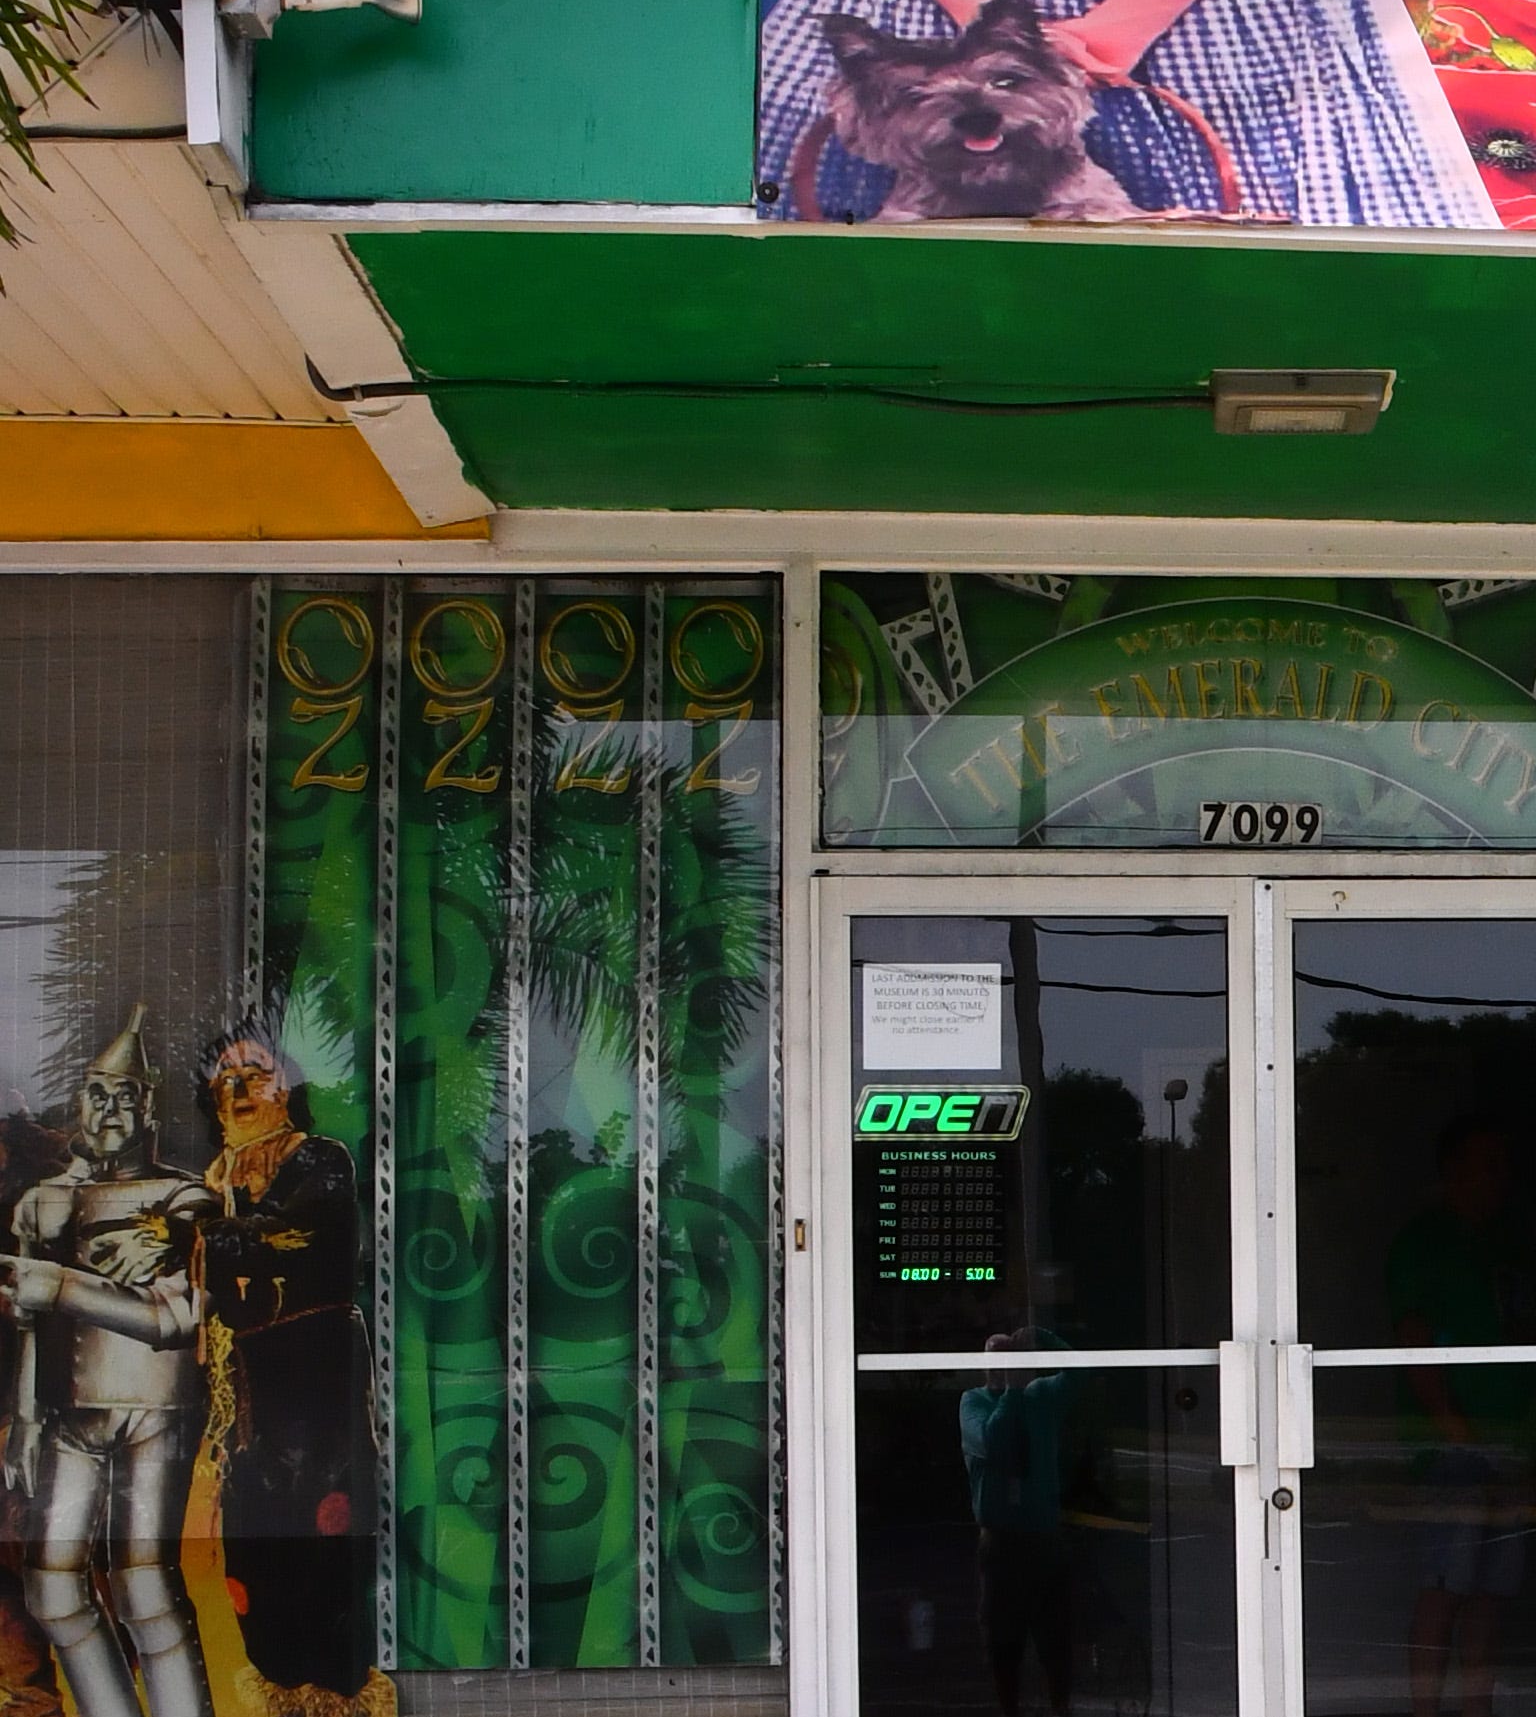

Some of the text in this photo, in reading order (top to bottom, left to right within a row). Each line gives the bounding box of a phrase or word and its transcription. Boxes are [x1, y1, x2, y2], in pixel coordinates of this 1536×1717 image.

[1115, 617, 1399, 661] WELCOME TO
[950, 701, 1082, 813] THE
[1090, 657, 1393, 742] EMERALD
[1203, 803, 1319, 844] 7099
[871, 973, 893, 983] LAST
[961, 973, 975, 983] TO
[976, 974, 995, 984] THE
[874, 987, 990, 997] MUSEUM IS 30 MINUTES
[876, 1000, 912, 1010] BEFORE
[915, 1000, 957, 1010] CLOSING
[871, 1015, 887, 1024] We
[890, 1015, 917, 1026] might
[919, 1015, 943, 1024] close
[881, 1151, 997, 1161] BUSINESS HOURS
[879, 1185, 896, 1193] TUE
[879, 1202, 897, 1210] WED
[879, 1219, 897, 1227] THU
[879, 1236, 896, 1244] FRI
[879, 1253, 896, 1262] SAT
[879, 1271, 897, 1279] SUN
